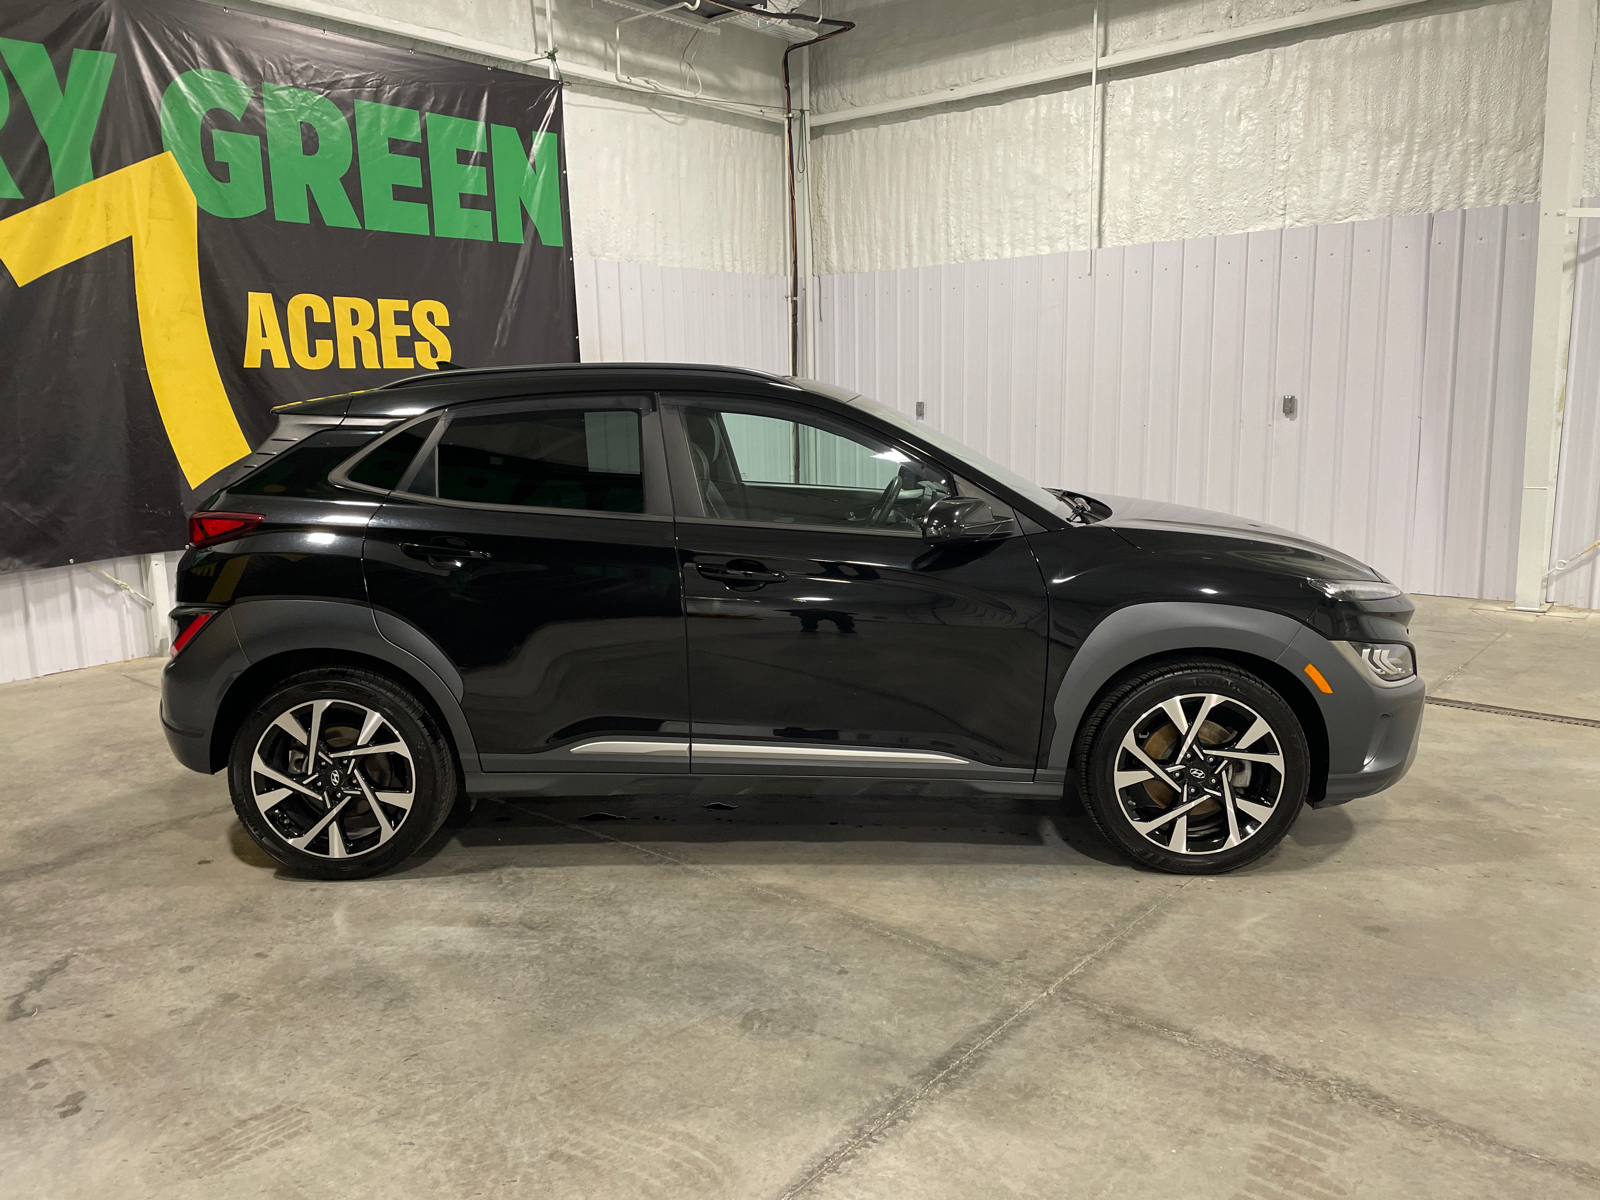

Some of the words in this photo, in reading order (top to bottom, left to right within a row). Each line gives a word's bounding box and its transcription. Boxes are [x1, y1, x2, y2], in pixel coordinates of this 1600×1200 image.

[160, 68, 564, 248] GREEN
[243, 291, 452, 371] ACRES
[1193, 677, 1250, 694] KUMHO
